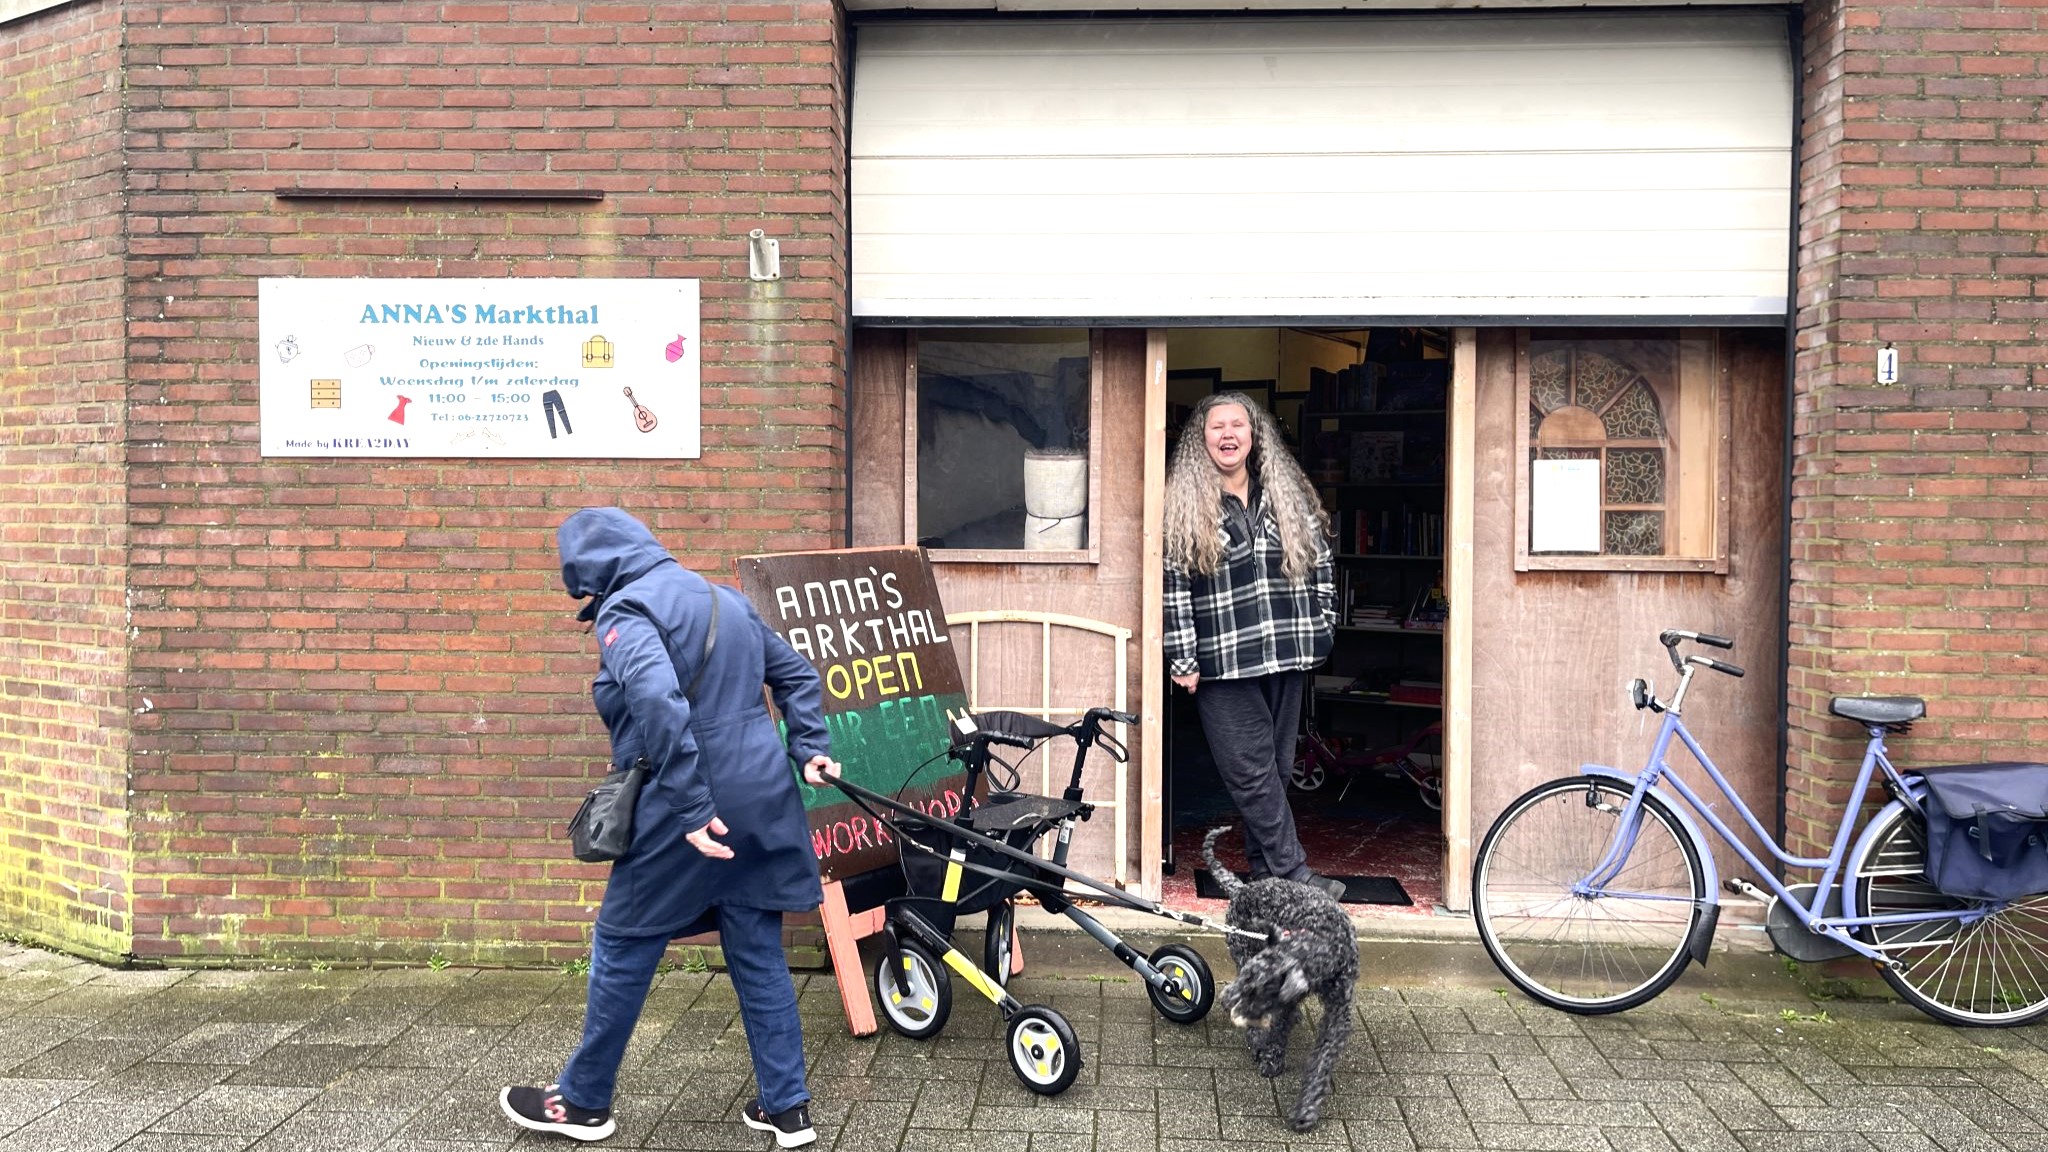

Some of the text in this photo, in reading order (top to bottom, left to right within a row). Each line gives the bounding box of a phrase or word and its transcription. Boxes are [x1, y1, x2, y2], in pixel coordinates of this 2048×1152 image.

[359, 303, 599, 325] ANNA'S Markthal
[412, 335, 545, 347] Nieuw & 2de Hands
[419, 358, 539, 371] Openingstijden:
[1880, 353, 1895, 380] 4
[379, 375, 465, 388] Woensdag
[506, 375, 579, 388] zaterdag
[428, 393, 466, 404] 11:00
[490, 393, 531, 404] 15:00
[285, 438, 313, 448] Made
[316, 438, 329, 450] by
[775, 566, 904, 621] ANNA'S
[775, 608, 949, 661] ARKTHAL
[826, 651, 923, 700] OPEN
